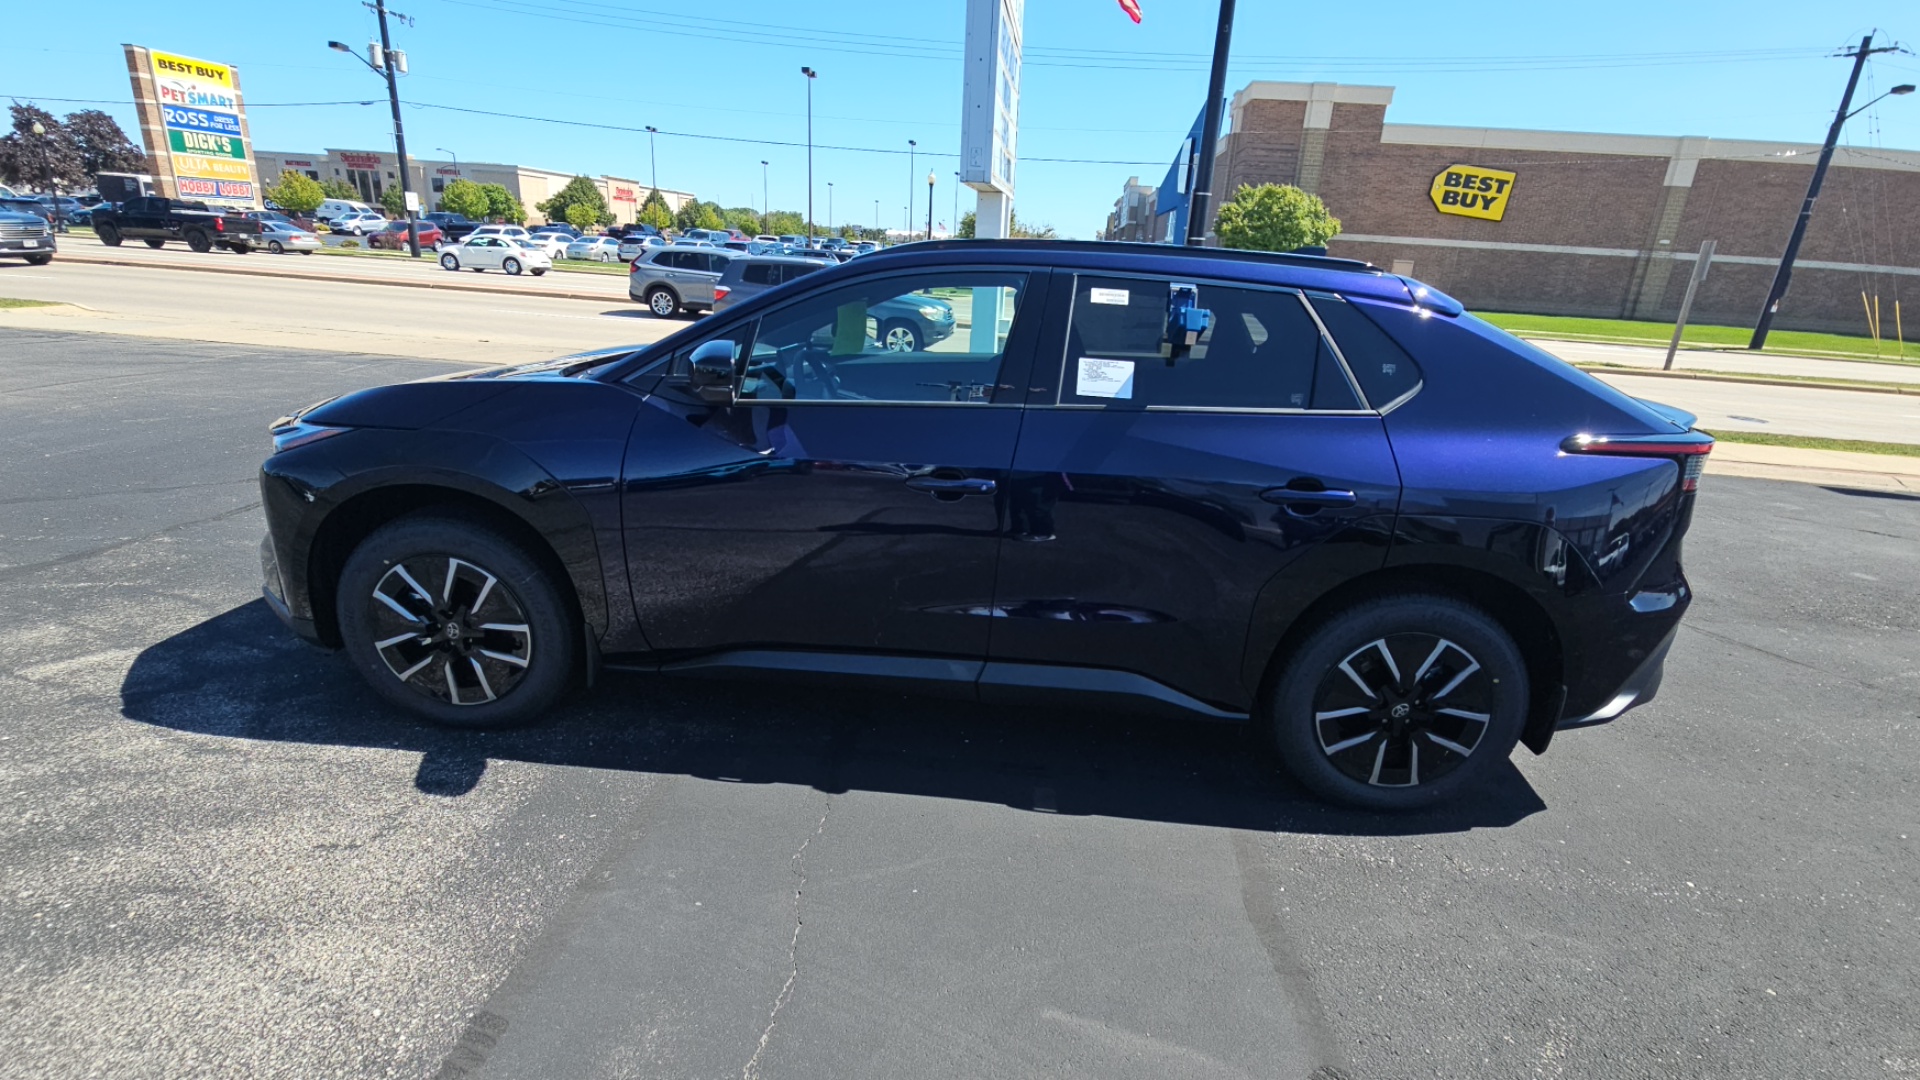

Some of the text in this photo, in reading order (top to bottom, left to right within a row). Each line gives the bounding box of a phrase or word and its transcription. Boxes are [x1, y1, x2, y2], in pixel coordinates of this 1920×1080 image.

[157, 58, 224, 80] BEST BUY
[161, 85, 233, 109] PETSMART
[164, 108, 209, 128] ROSS
[210, 121, 224, 130] FOR
[183, 131, 232, 153] DICK'S
[178, 156, 247, 174] ULTA BEAUTY
[180, 180, 251, 197] HOBBY LOBBY
[1444, 171, 1510, 194] BEST
[1441, 189, 1500, 211] BUY
